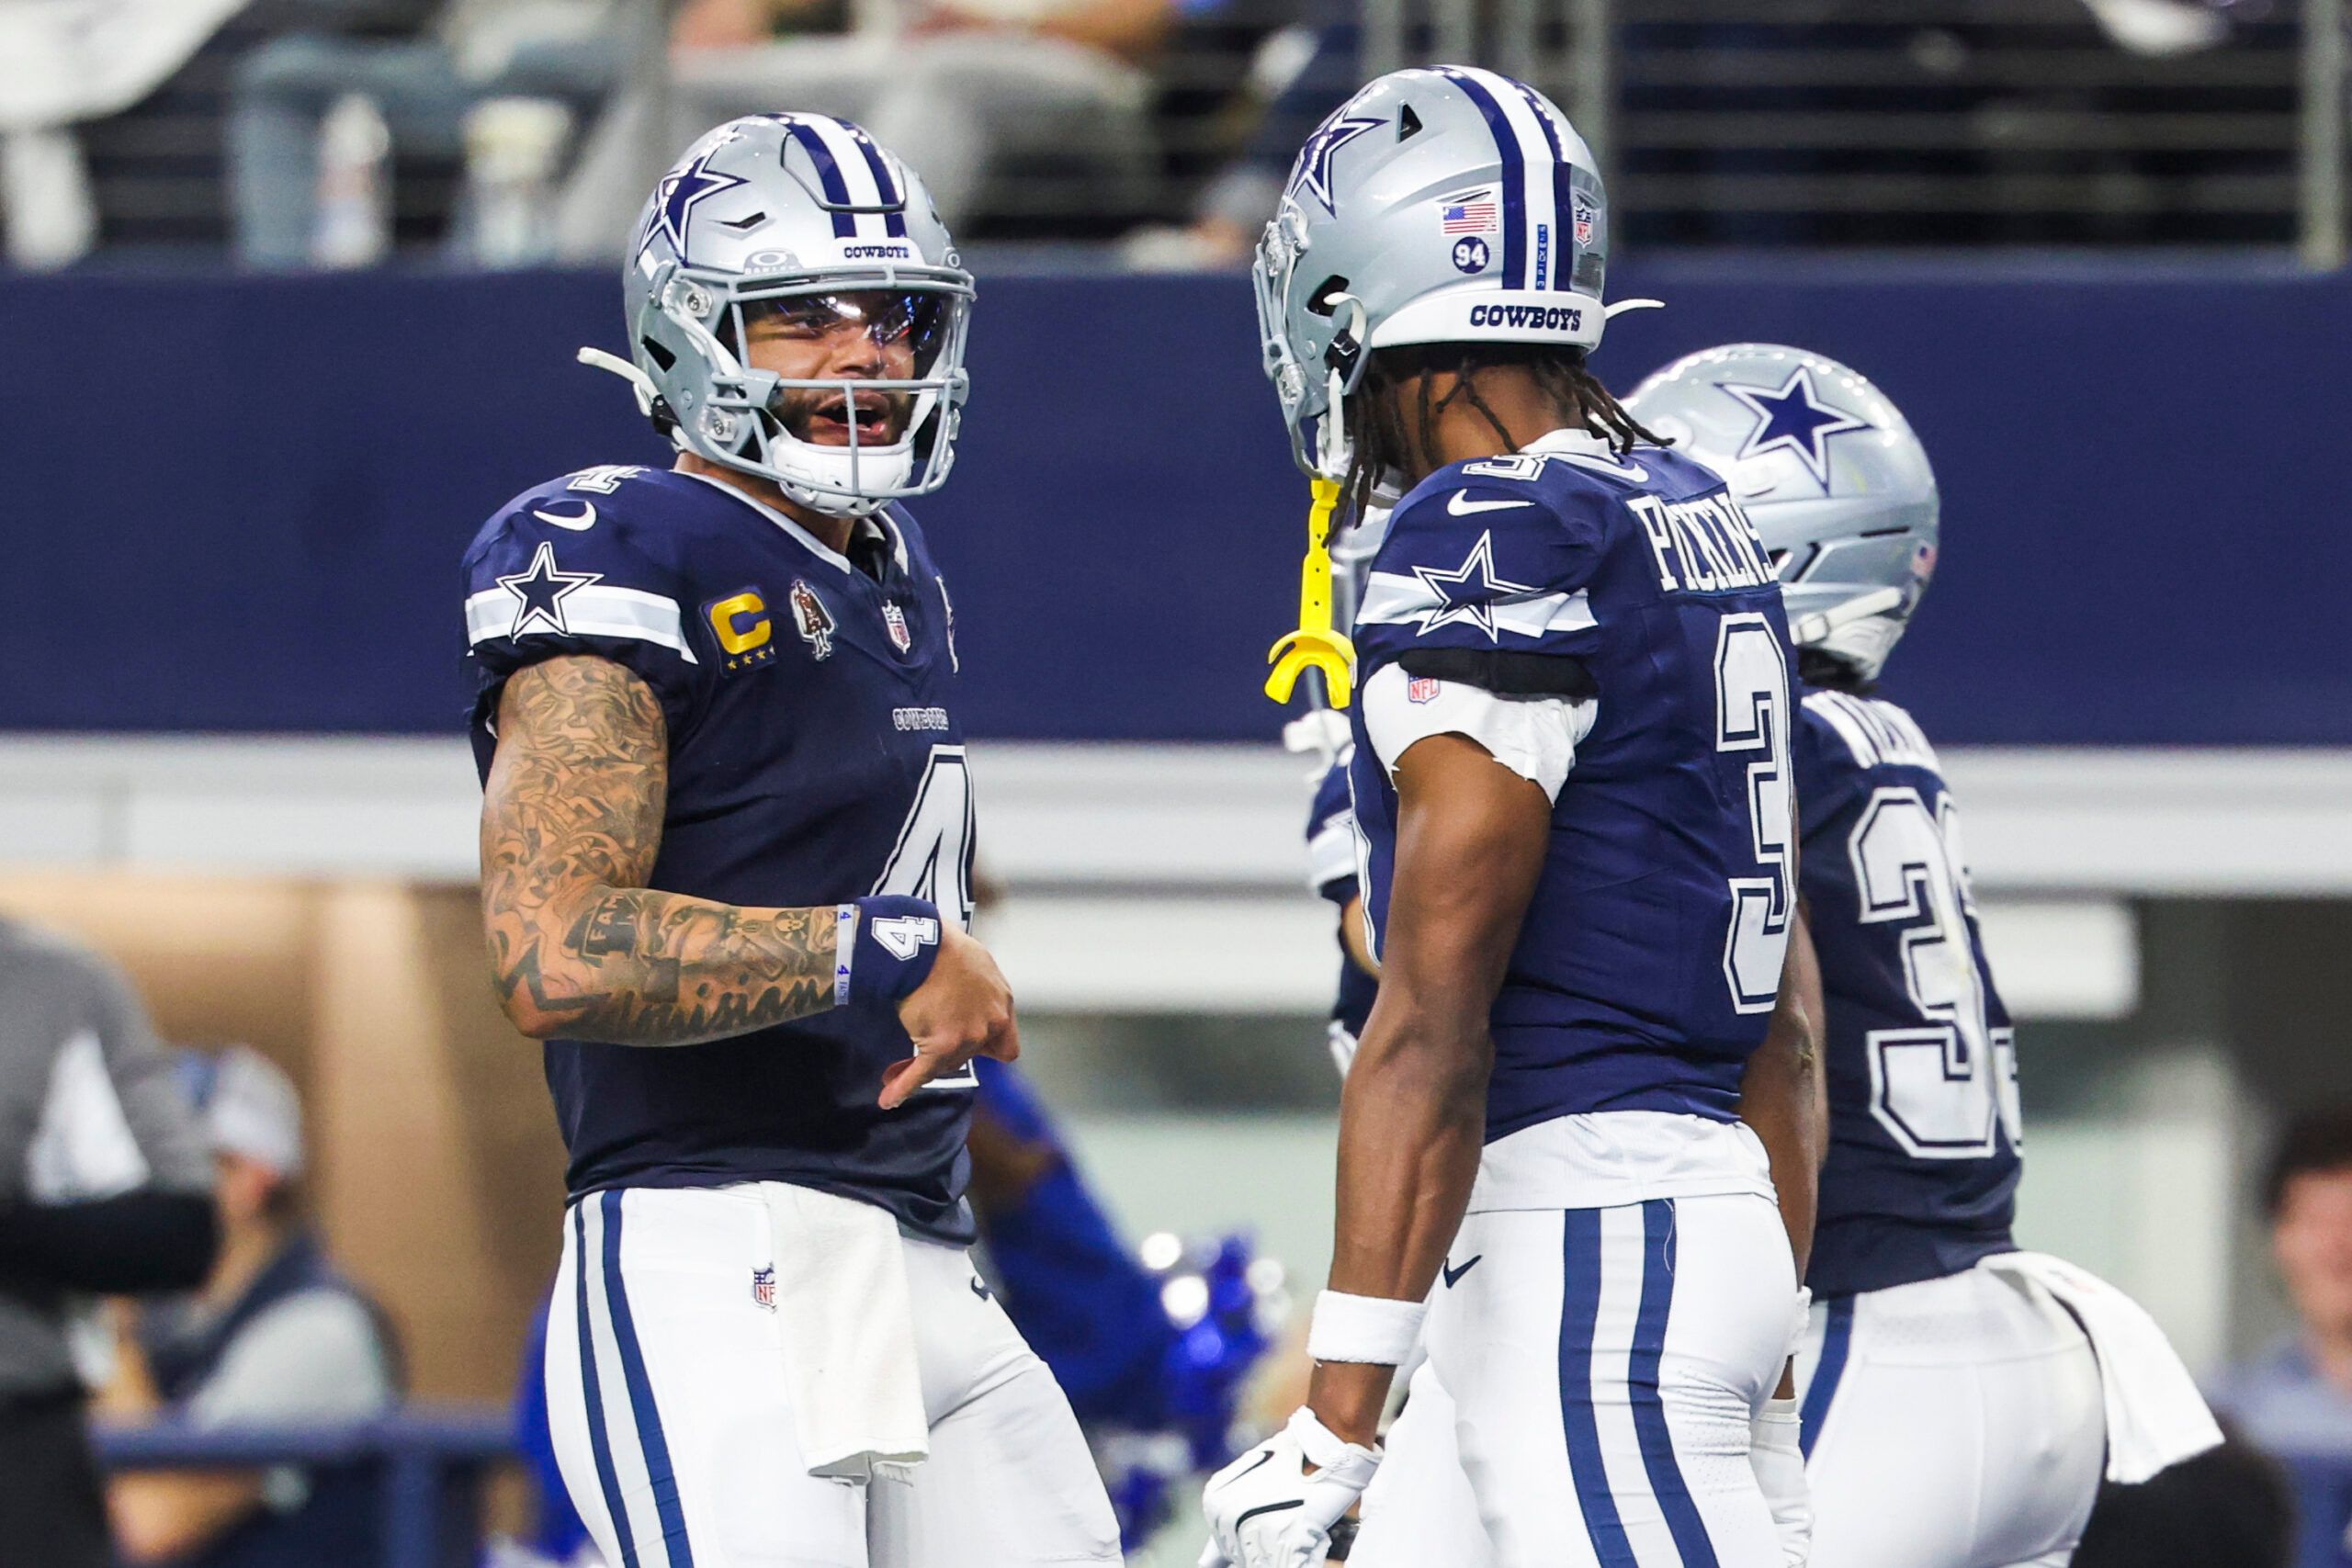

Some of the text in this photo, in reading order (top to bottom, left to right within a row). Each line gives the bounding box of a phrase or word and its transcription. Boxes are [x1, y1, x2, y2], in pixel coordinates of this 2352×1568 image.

[843, 245, 910, 259] COWBOYS
[1454, 243, 1486, 267] 94
[1469, 304, 1582, 333] COWBOYS
[709, 592, 773, 655] C
[1410, 679, 1438, 699] NFL
[1713, 612, 1798, 1015] 3
[871, 915, 939, 962] 4
